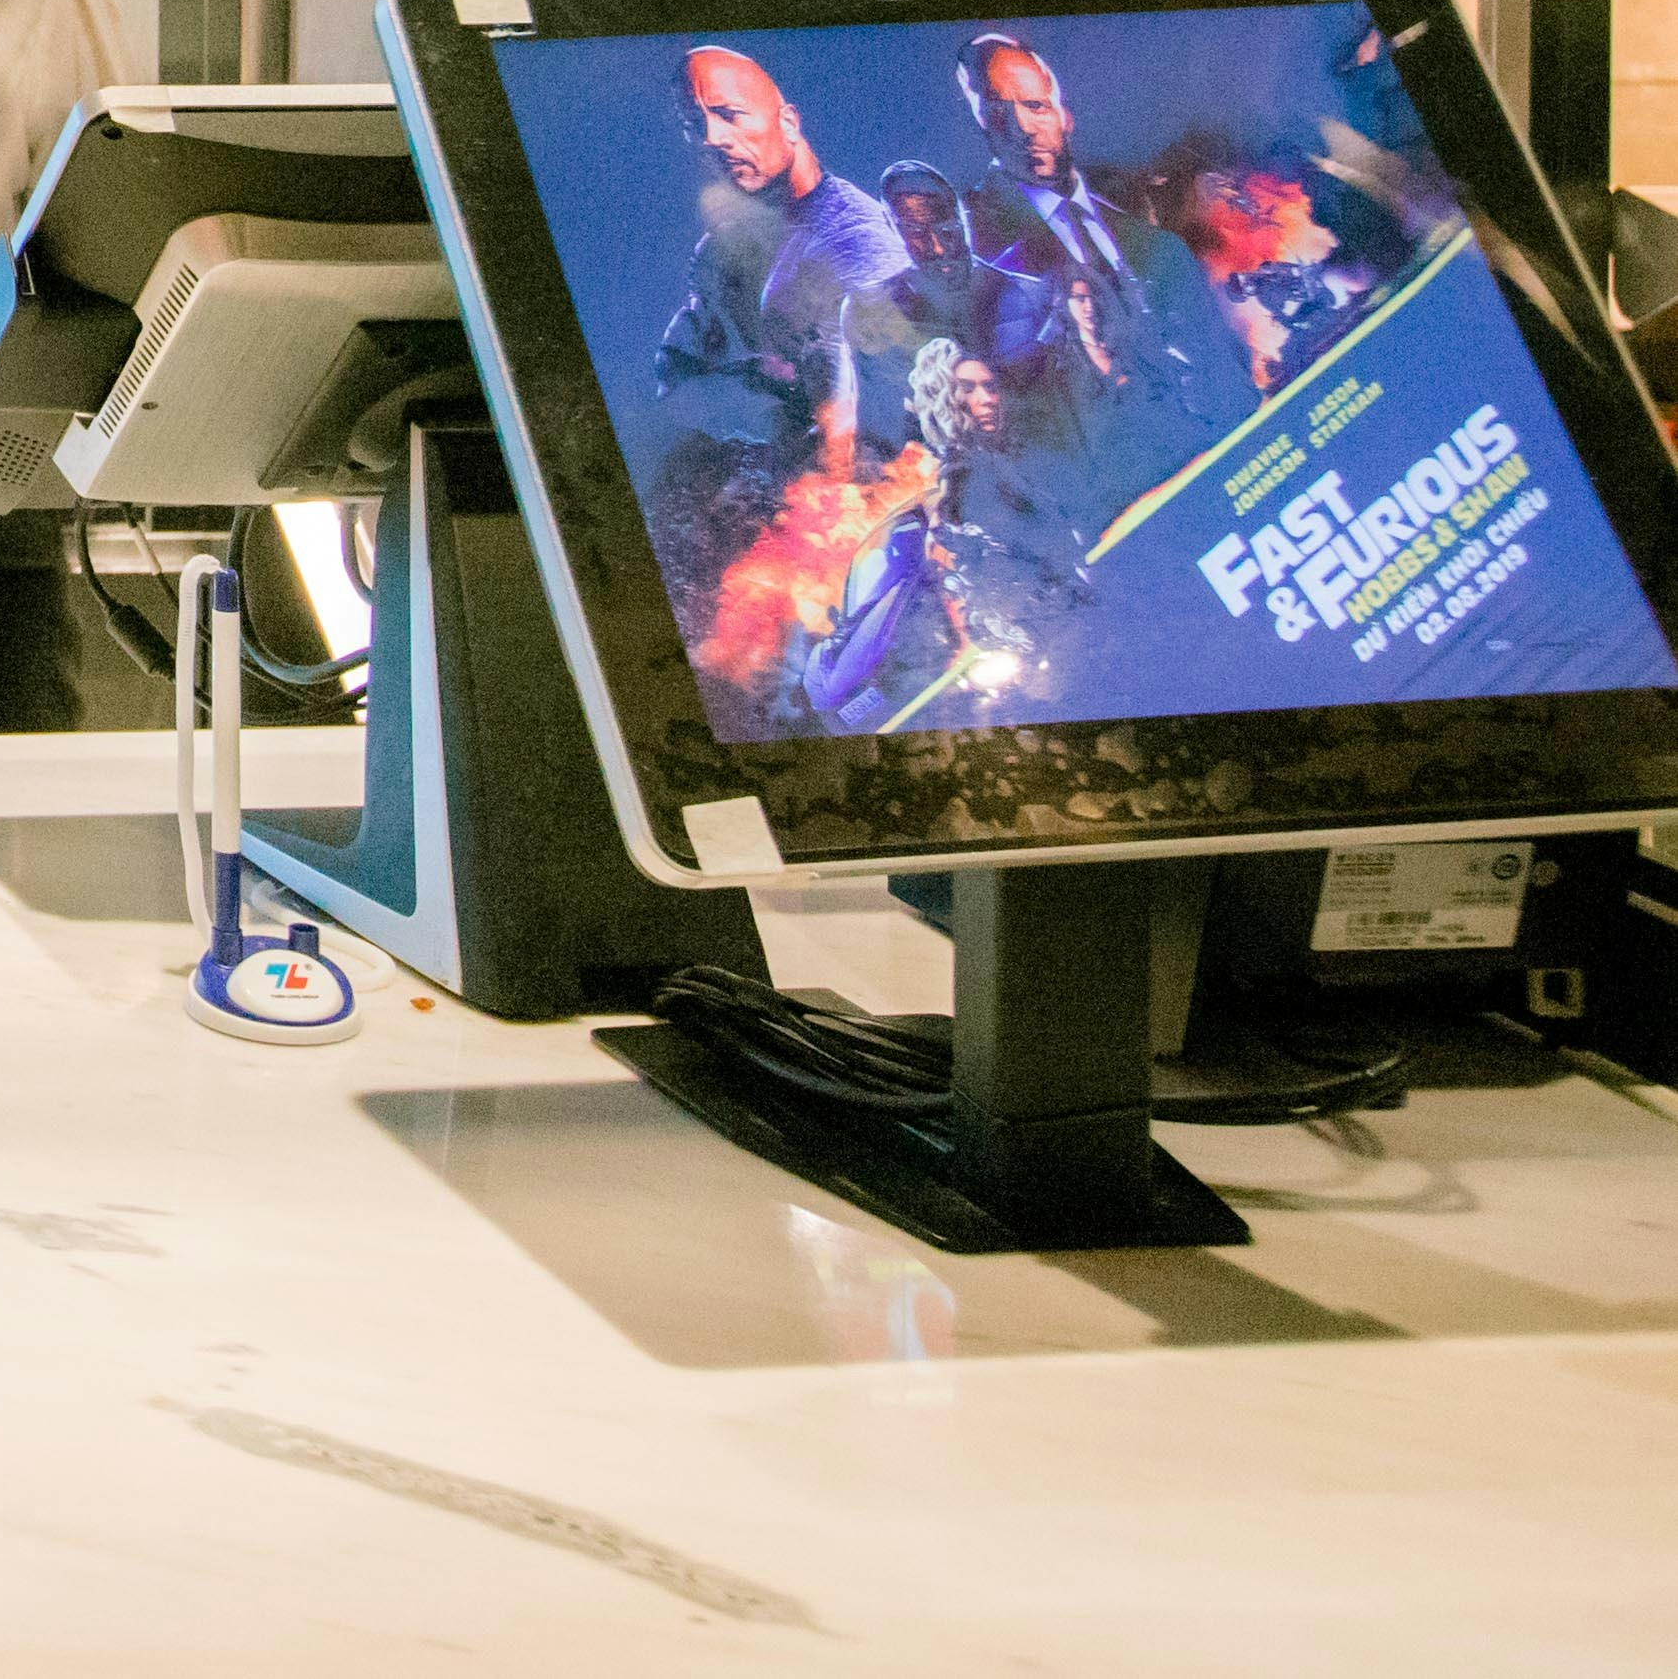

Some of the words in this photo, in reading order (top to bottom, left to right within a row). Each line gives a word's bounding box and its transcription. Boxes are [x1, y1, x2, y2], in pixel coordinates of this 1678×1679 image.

[1308, 377, 1361, 427] JASON
[1308, 382, 1384, 449] STATHAM
[1224, 433, 1293, 497] DWAYNE
[1233, 448, 1307, 516] JOHNSON
[1196, 469, 1355, 618] FAST
[1265, 586, 1318, 643] &
[1293, 403, 1518, 631] FURIOUS
[1345, 533, 1441, 624] HOBBS
[1431, 518, 1459, 548] &
[1449, 453, 1530, 531] SHAW
[1415, 544, 1529, 645] 02.08.2019
